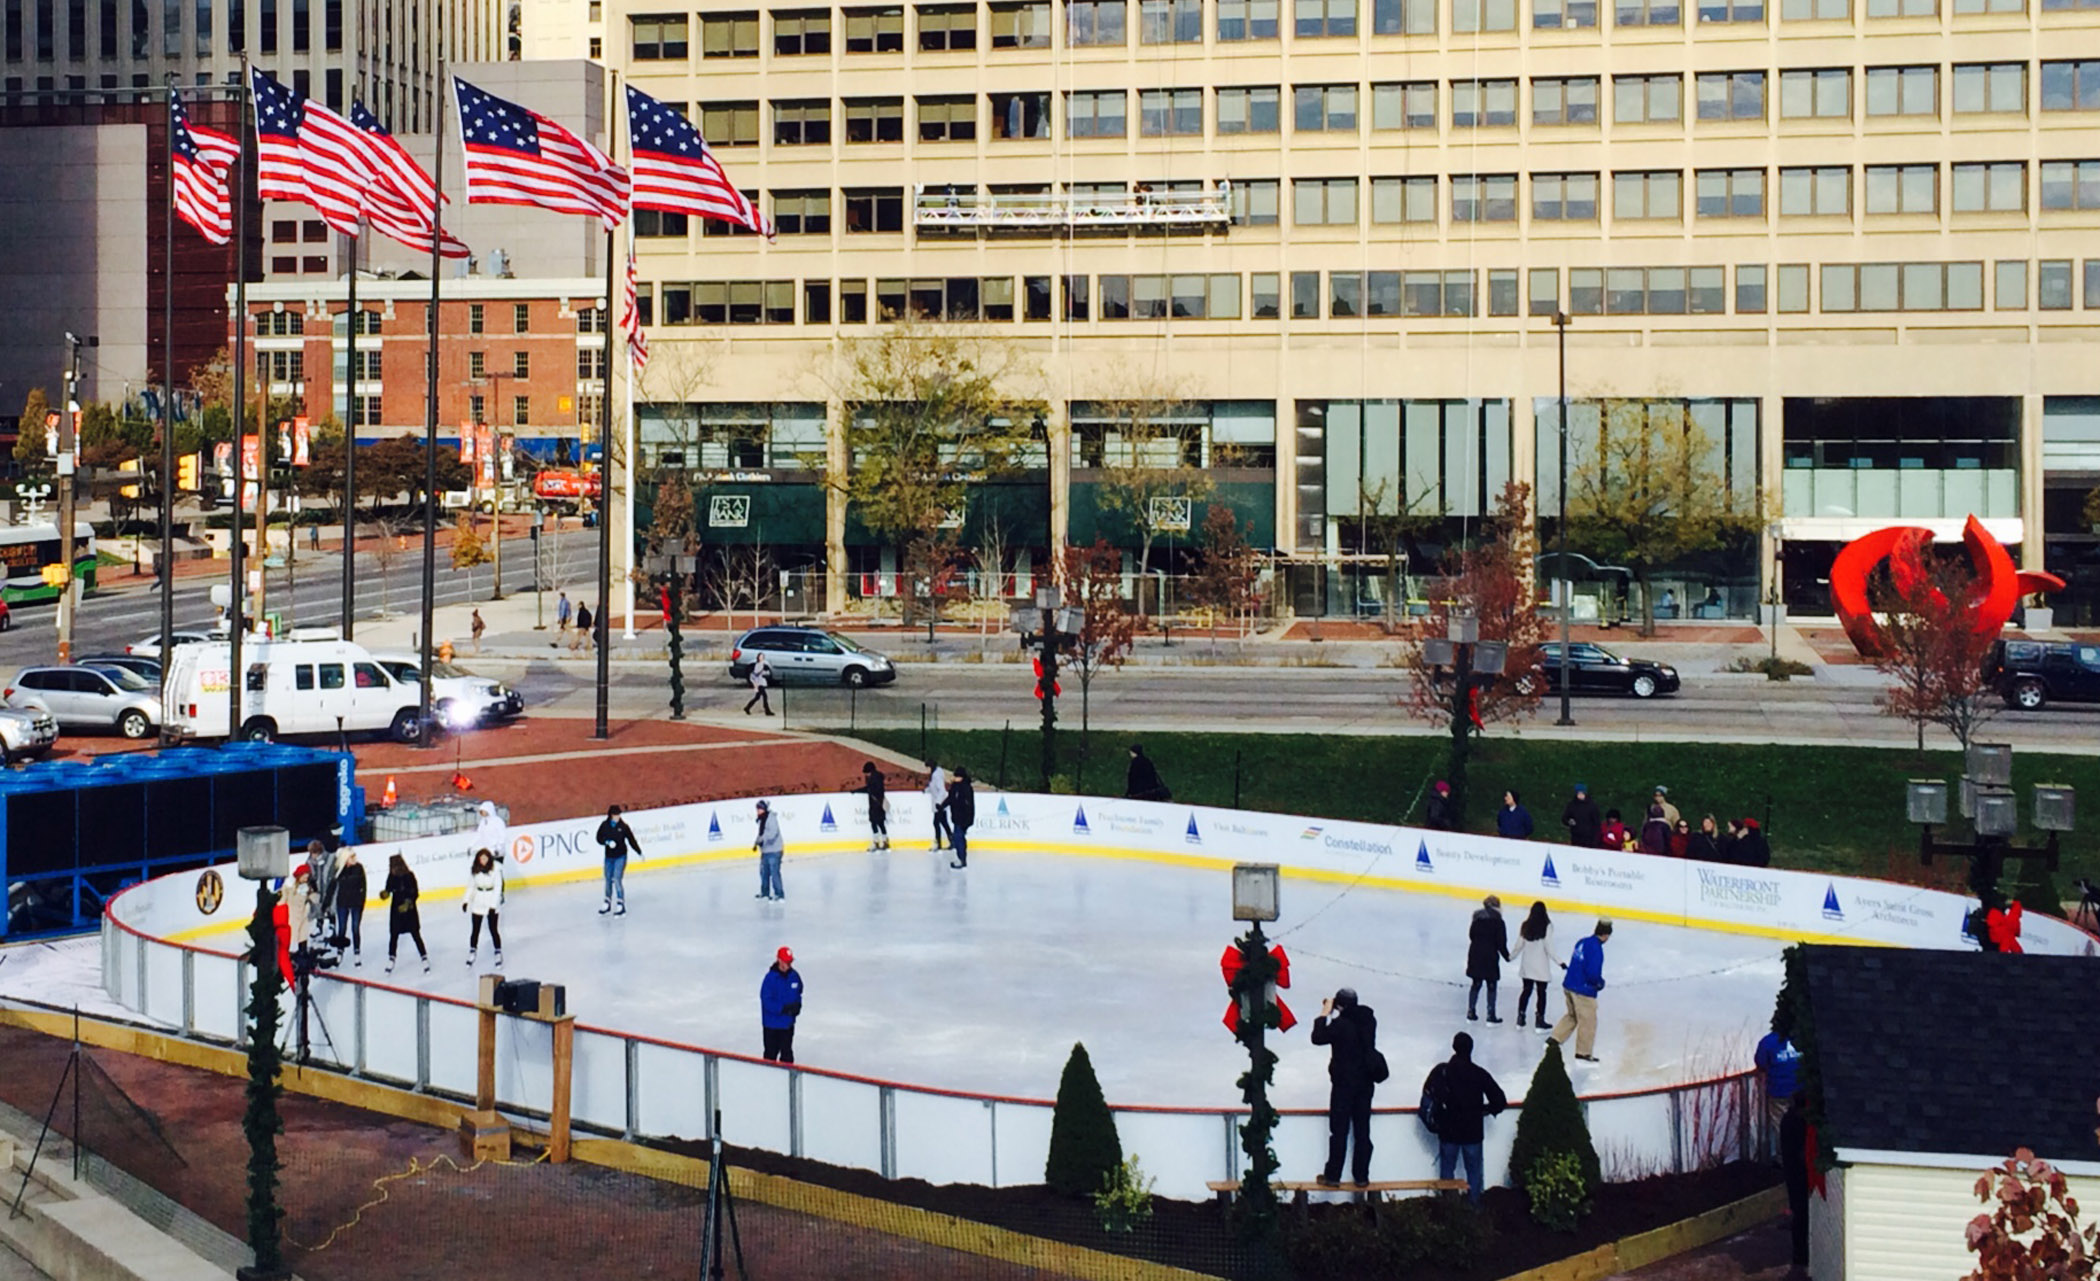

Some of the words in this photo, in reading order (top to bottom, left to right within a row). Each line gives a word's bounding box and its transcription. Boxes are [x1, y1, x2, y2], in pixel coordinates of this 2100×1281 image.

[338, 758, 351, 816] aggreko
[999, 818, 1030, 831] RINK
[540, 830, 589, 859] PNC
[1324, 835, 1393, 855] Constellation
[1464, 850, 1521, 867] Development
[1572, 863, 1606, 877] Bobby's
[1608, 868, 1645, 880] Portable
[1697, 868, 1780, 893] WATERFRONT
[1584, 877, 1633, 890] Restrooms
[1700, 885, 1782, 906] PARTNERSHIP
[1854, 896, 1881, 908] Ayers
